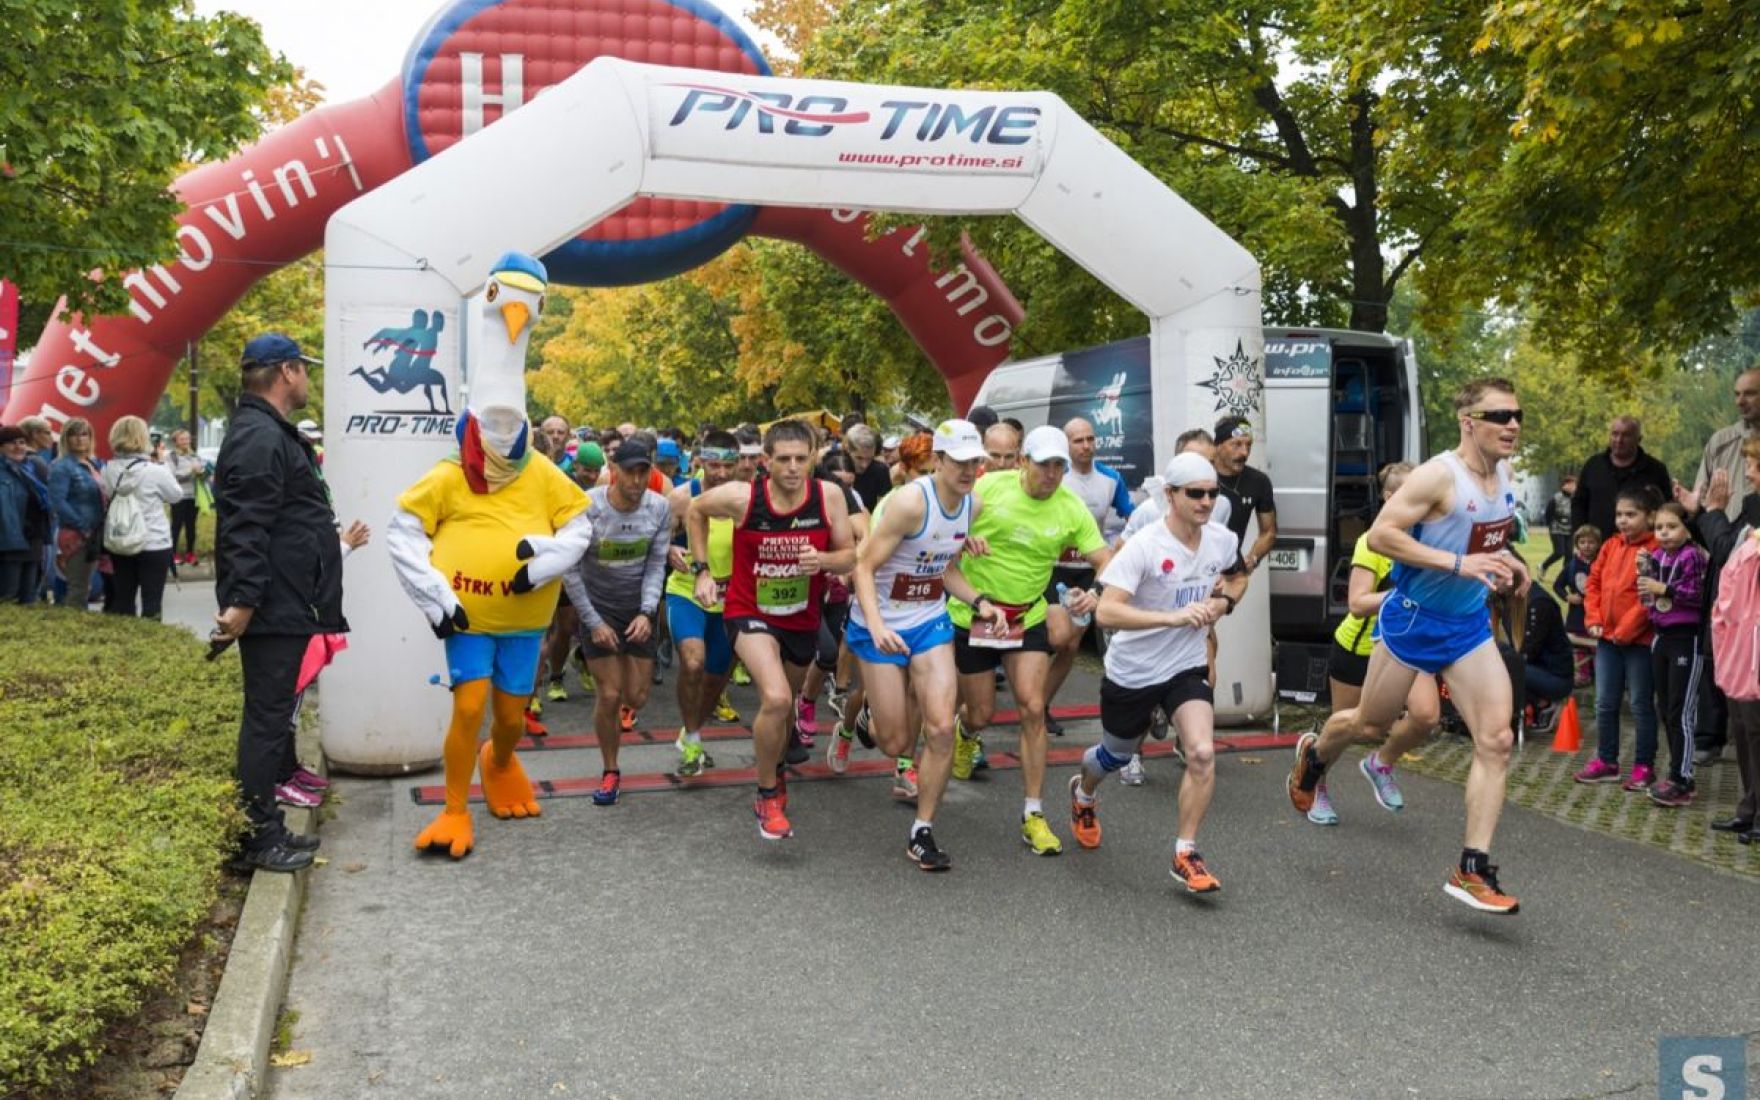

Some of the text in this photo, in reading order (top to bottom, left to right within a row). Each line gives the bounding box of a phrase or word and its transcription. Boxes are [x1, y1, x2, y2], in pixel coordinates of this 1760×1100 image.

[838, 151, 1024, 168] www.protime.si
[345, 415, 455, 434] PRO-TIME
[762, 536, 809, 545] PREVOZI
[1482, 530, 1504, 548] 264
[453, 570, 513, 597] ŠTRK V
[906, 584, 931, 596] 216
[772, 587, 798, 600] 392
